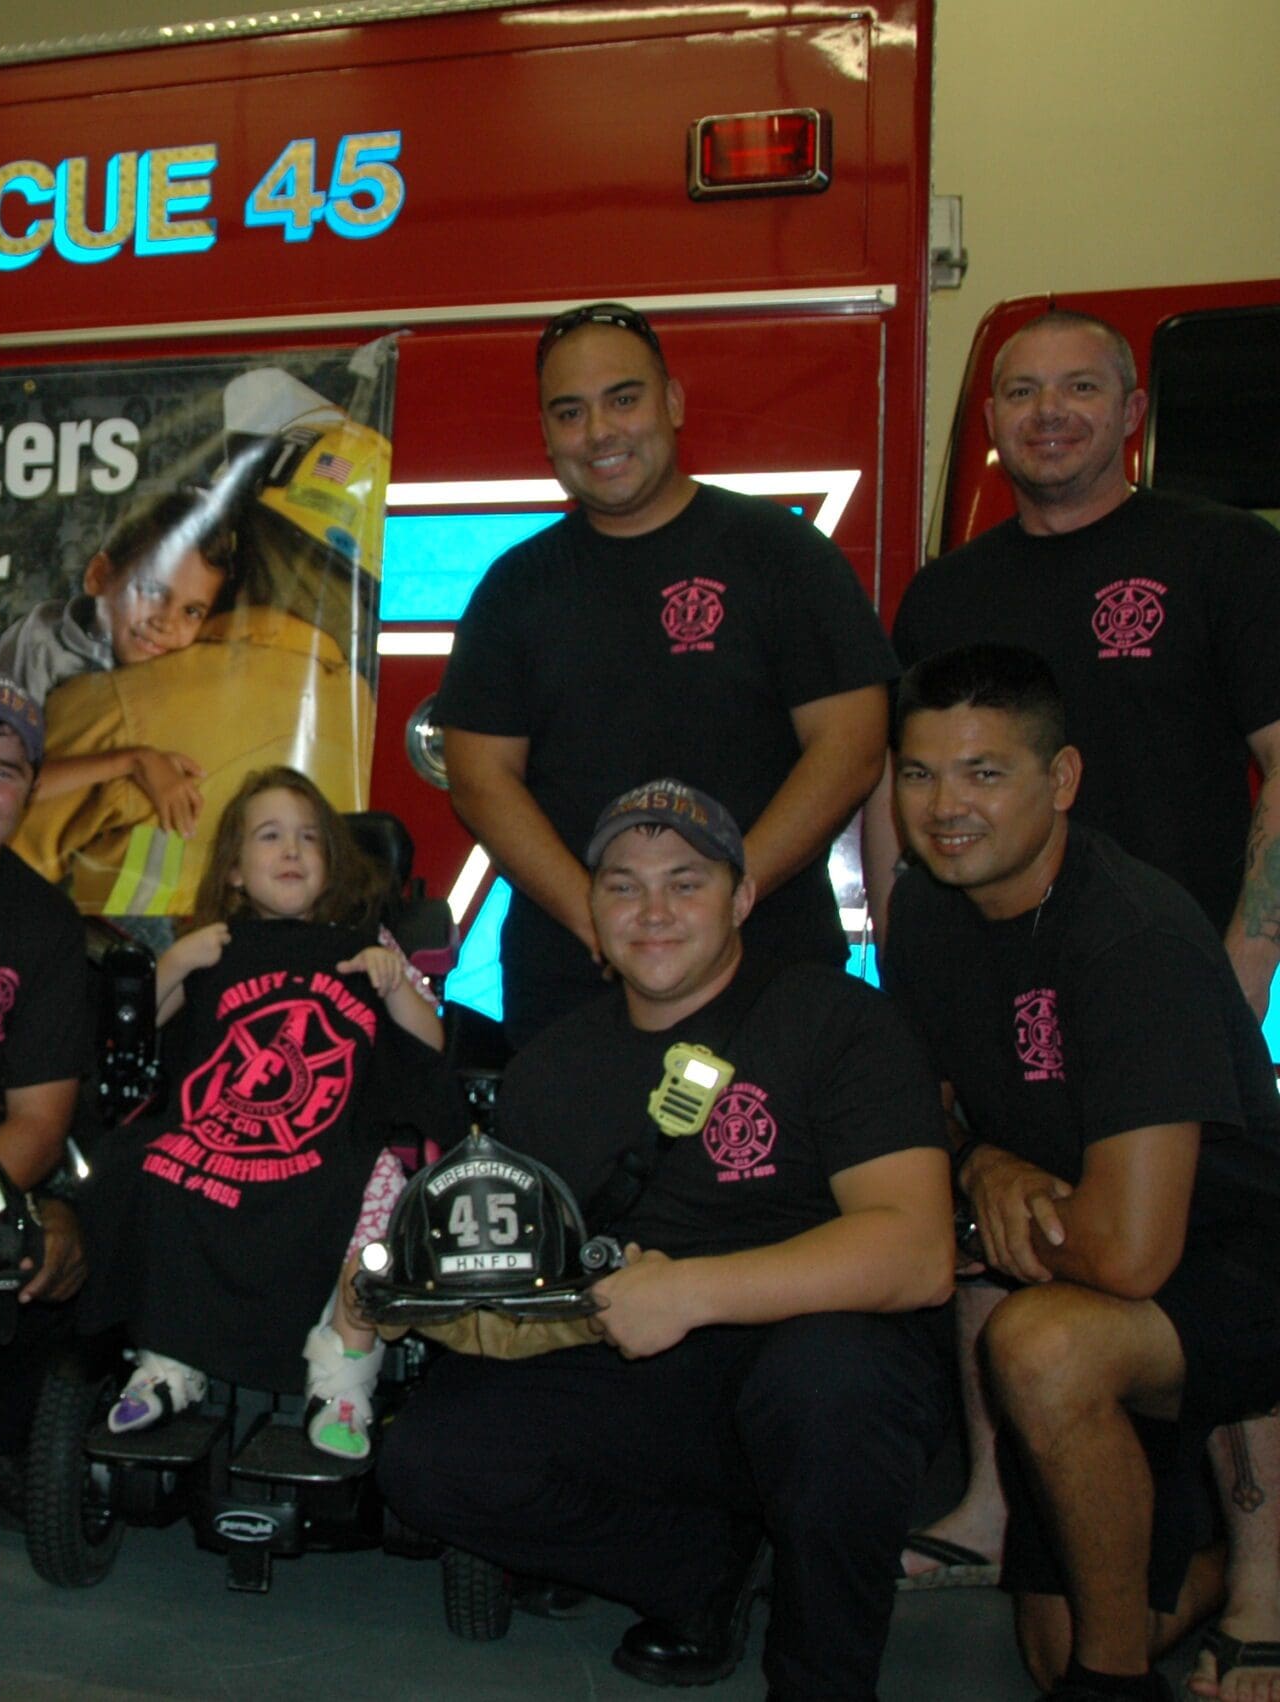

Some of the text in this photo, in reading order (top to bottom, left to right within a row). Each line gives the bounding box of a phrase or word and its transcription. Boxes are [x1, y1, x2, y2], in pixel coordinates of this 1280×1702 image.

[244, 131, 405, 242] 45
[142, 1153, 184, 1184] LOCAL
[203, 1150, 322, 1182] FIREFIGHTERS
[431, 1162, 533, 1193] FIREFIGHTER
[448, 1193, 518, 1247] 45
[456, 1255, 517, 1271] HNFD
